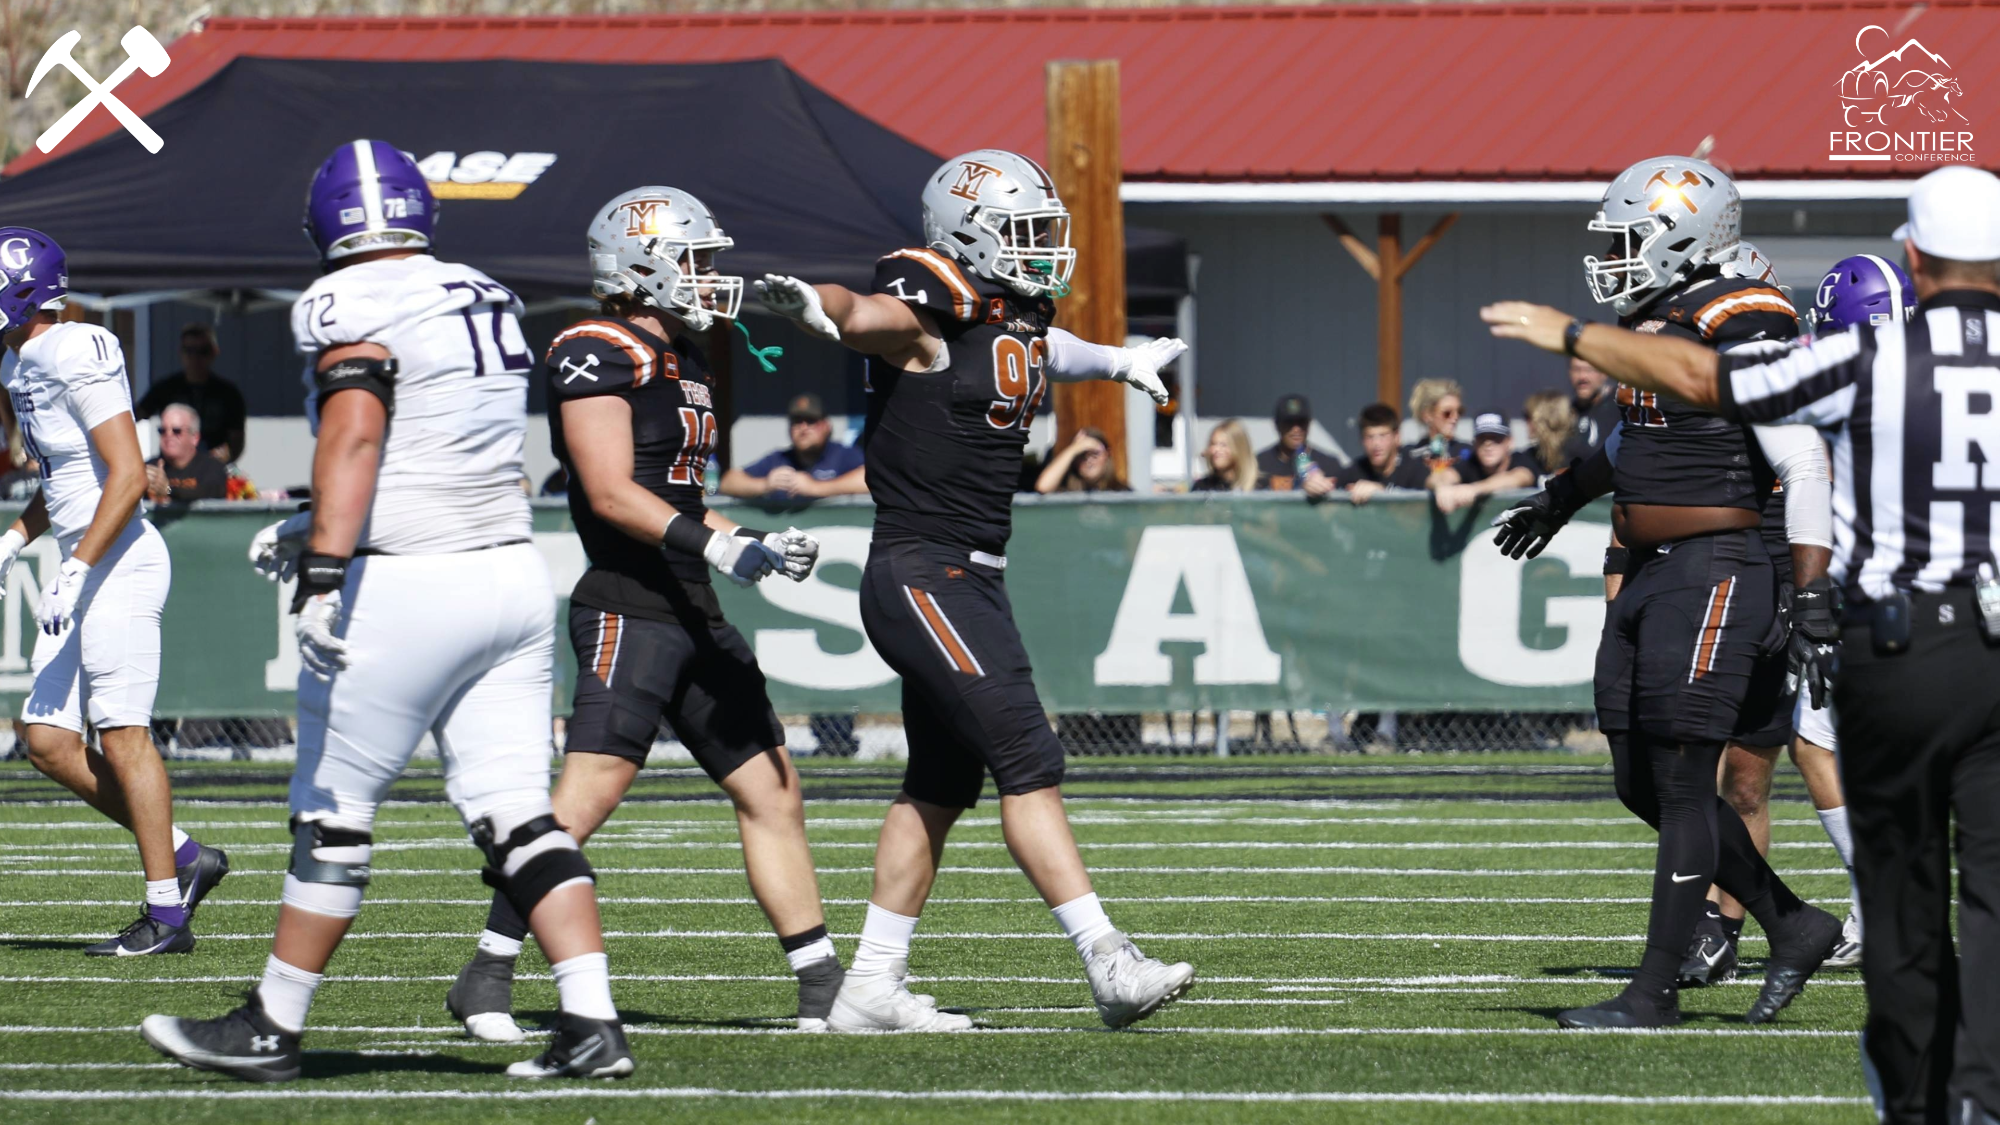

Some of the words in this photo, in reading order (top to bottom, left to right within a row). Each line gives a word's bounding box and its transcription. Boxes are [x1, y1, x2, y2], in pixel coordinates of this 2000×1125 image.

[404, 151, 558, 183] ASE
[384, 197, 408, 219] 72
[302, 292, 337, 338] 72
[91, 334, 109, 362] 11
[985, 334, 1047, 431] 92
[667, 407, 718, 487] 10
[1932, 366, 2000, 490] R
